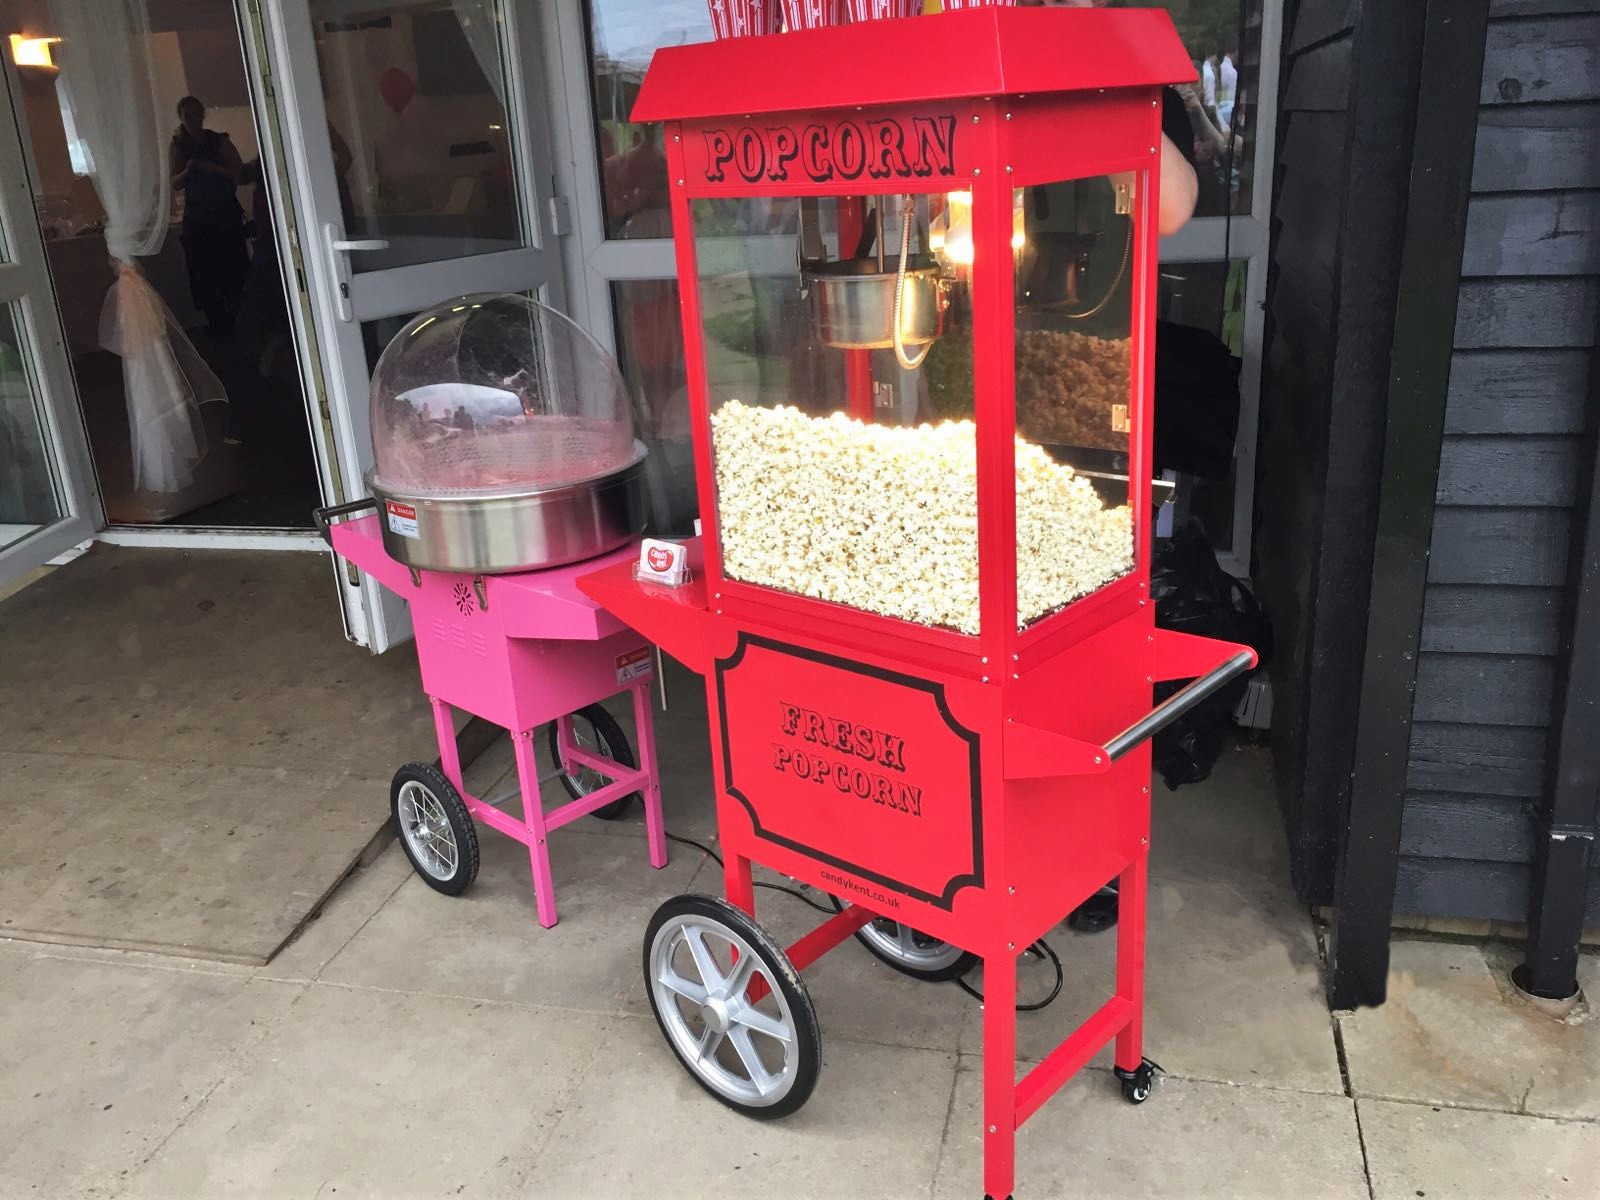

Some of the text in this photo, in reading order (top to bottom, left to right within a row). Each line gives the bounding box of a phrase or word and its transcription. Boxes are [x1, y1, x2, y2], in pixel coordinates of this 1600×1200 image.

[703, 115, 957, 183] POPCORN
[780, 701, 905, 772] FRESH
[771, 742, 921, 816] POPCORN
[820, 870, 900, 909] candykent.co.uk
